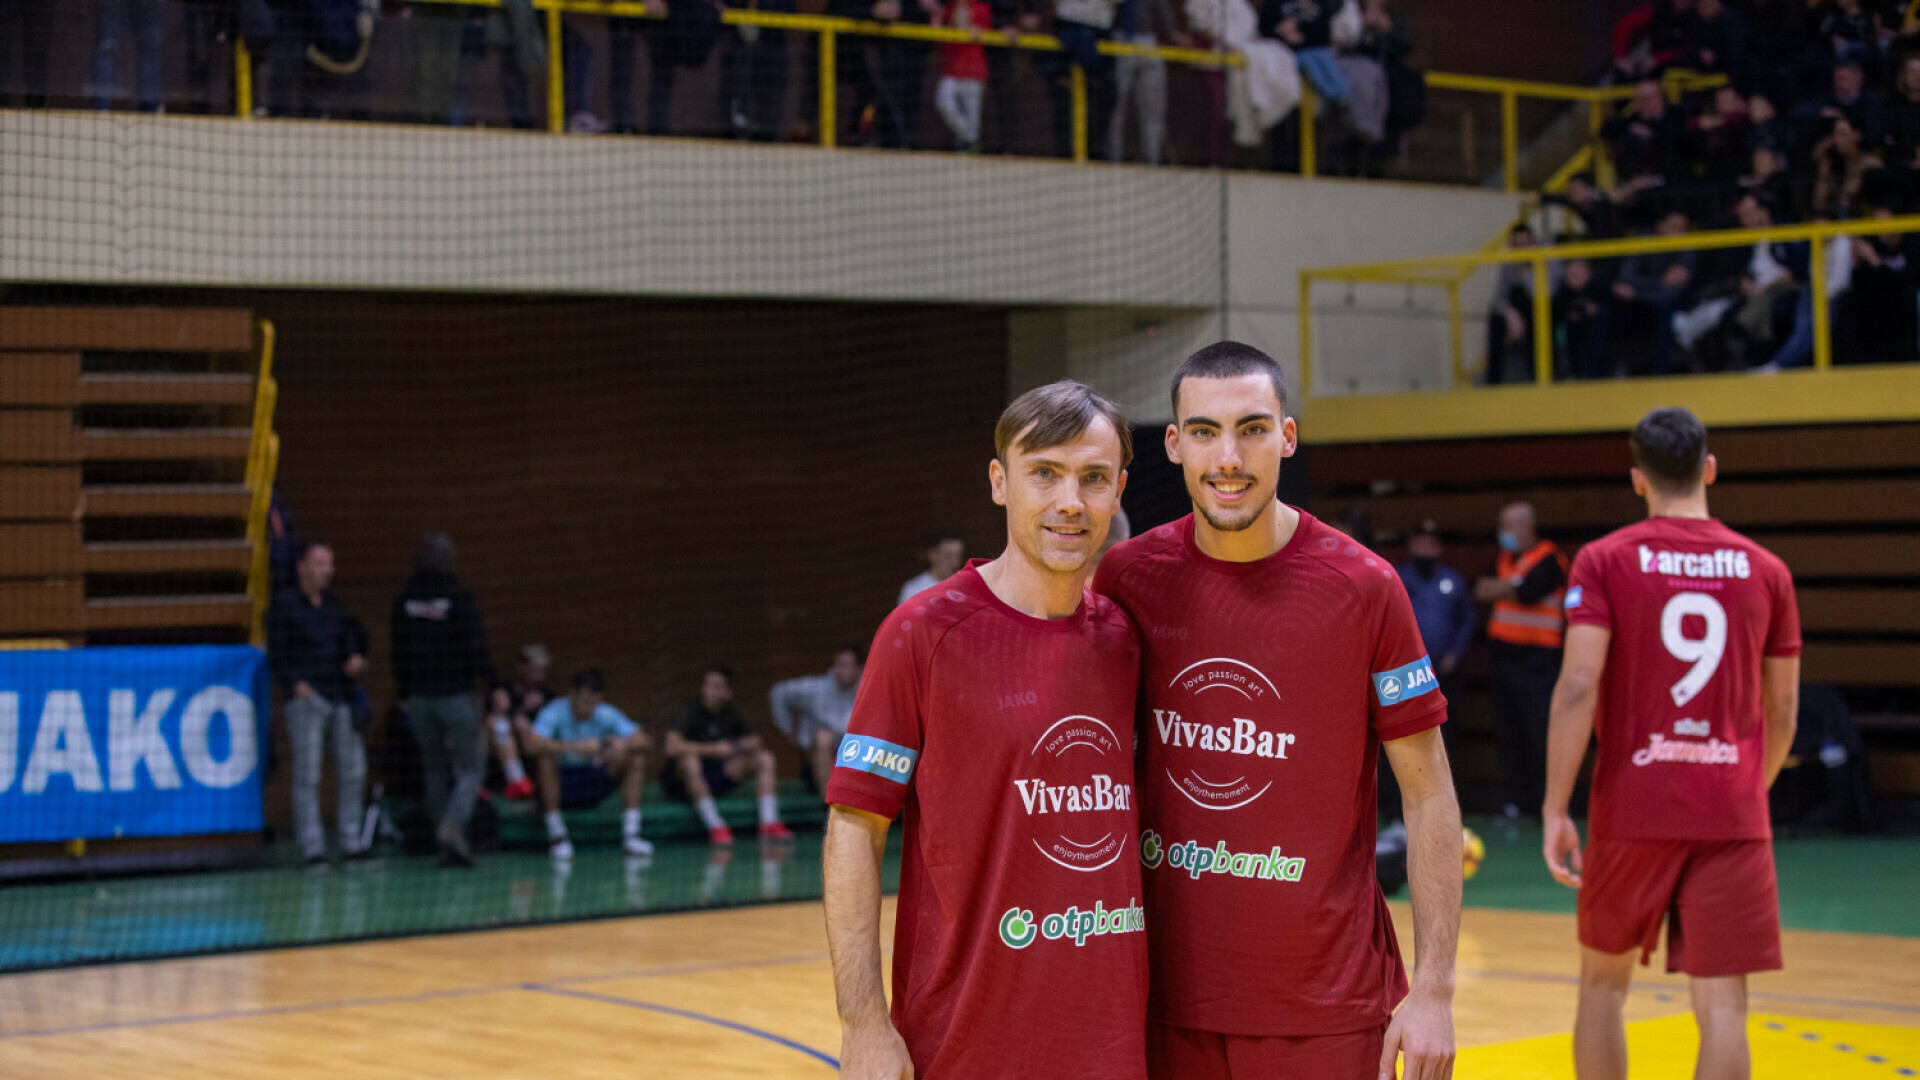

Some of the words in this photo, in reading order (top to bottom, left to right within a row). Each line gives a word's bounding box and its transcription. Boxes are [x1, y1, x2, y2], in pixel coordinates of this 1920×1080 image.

[1638, 544, 1751, 579] barcaffé
[1660, 591, 1728, 708] 9
[1182, 673, 1205, 690] love
[1207, 669, 1246, 684] passion
[1247, 680, 1264, 697] art
[997, 690, 1038, 711] JAKO
[1045, 734, 1064, 754] love
[1065, 726, 1097, 741] passion
[1099, 737, 1113, 751] art
[1153, 708, 1295, 760] VivasBar
[862, 745, 911, 774] JAKO
[1013, 774, 1131, 815] VivasBar
[1183, 777, 1251, 800] enjoythemoment
[1168, 840, 1306, 882] otpbanka
